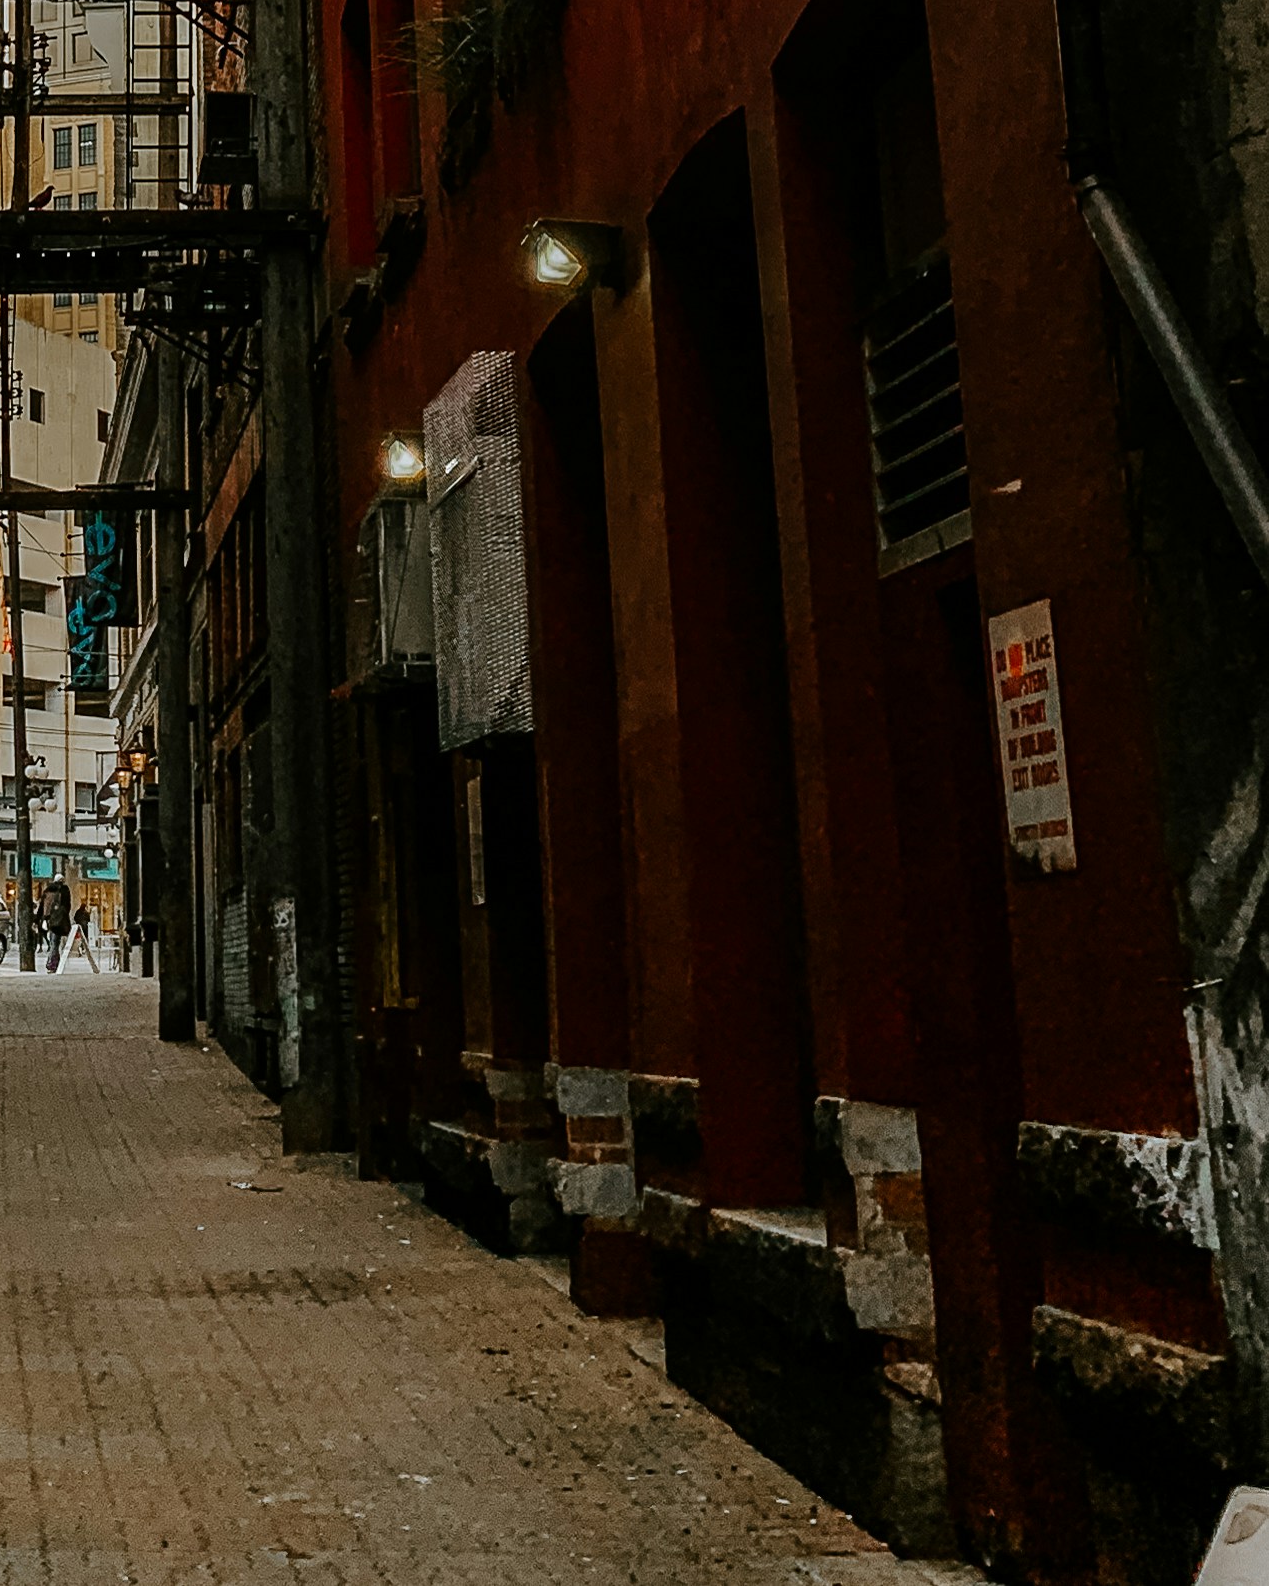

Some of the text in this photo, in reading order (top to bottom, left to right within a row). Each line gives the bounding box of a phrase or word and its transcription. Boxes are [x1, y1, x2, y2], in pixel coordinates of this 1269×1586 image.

[1025, 635, 1051, 664] PLACE
[1001, 667, 1049, 702] DUMPSTERS
[1021, 699, 1047, 728] FRONT
[1012, 760, 1060, 792] EXIT DOORS
